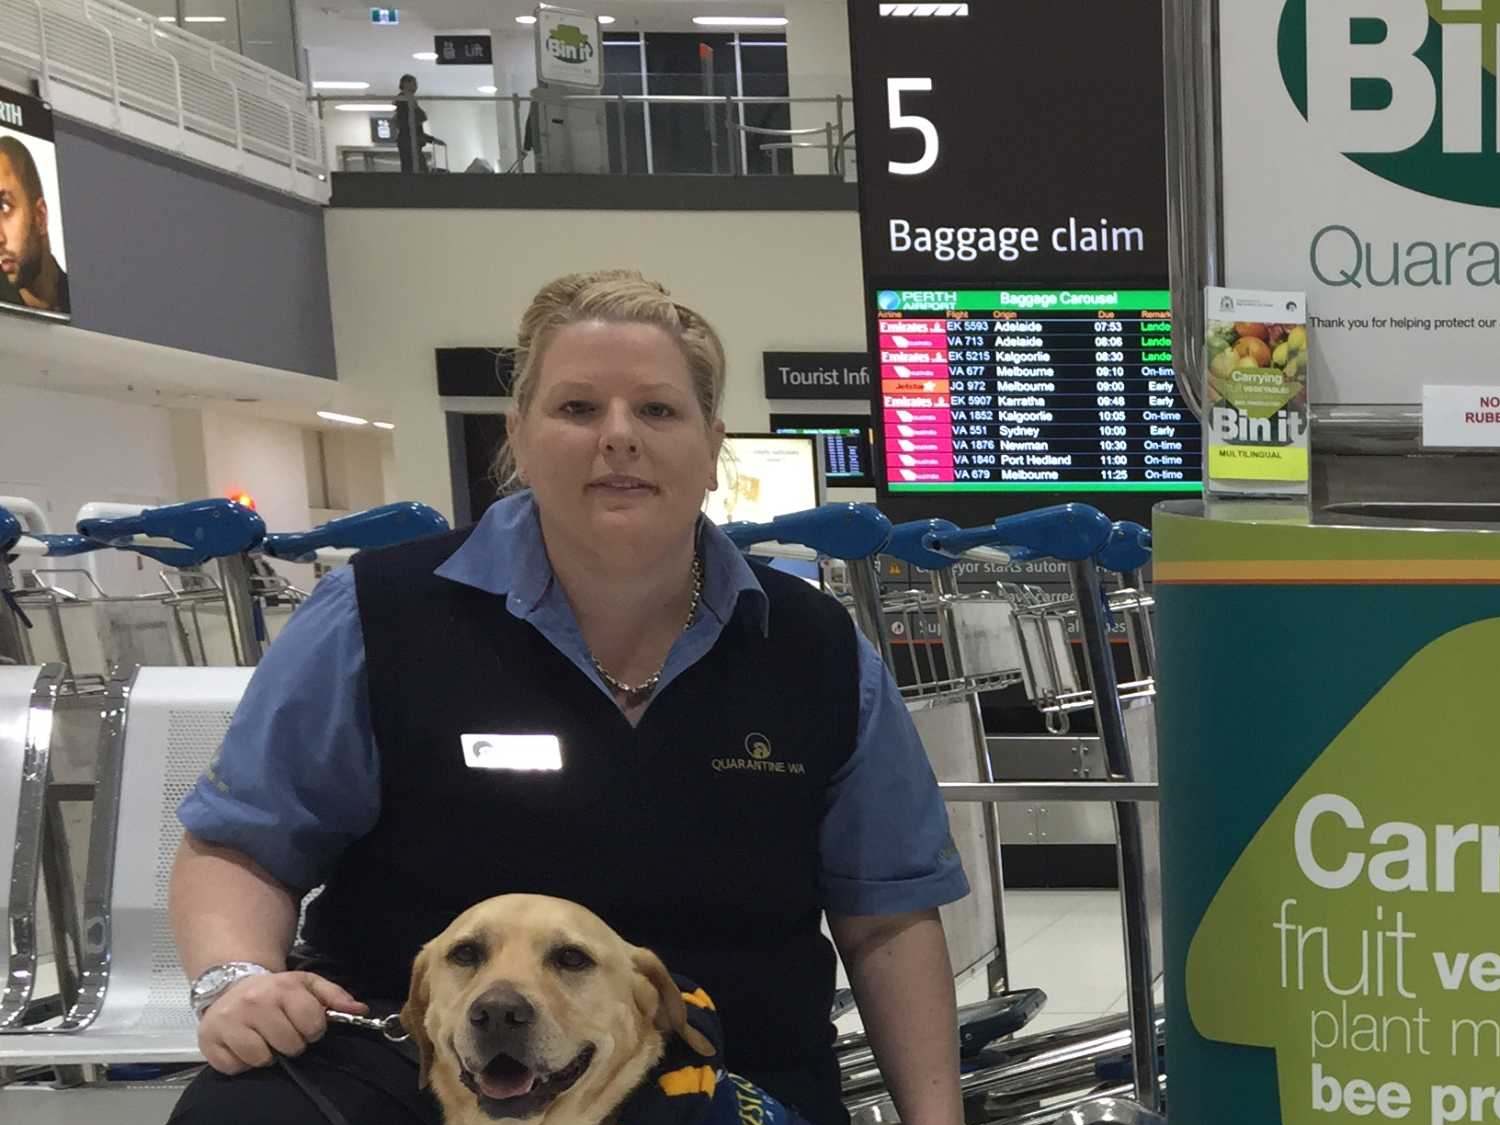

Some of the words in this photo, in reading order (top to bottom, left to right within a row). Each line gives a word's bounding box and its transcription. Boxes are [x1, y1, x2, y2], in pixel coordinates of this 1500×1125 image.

[464, 44, 484, 57] Lift
[551, 38, 579, 60] Bin
[886, 77, 940, 175] 5
[888, 219, 1039, 262] Baggage
[1051, 217, 1144, 251] claim
[902, 291, 957, 301] PERTH
[1000, 291, 1058, 308] Baggage
[1060, 291, 1118, 304] Carousel
[1098, 310, 1115, 319] Due
[946, 321, 962, 331] EK
[964, 321, 989, 331] 5593
[994, 321, 1043, 332] Adelaide
[1094, 322, 1123, 332] 07:53
[1309, 316, 1345, 328] Thank
[1348, 318, 1369, 331] you
[1371, 317, 1387, 328] for
[1390, 317, 1431, 331] helping
[1434, 317, 1475, 331] protect
[1477, 319, 1496, 328] our
[947, 336, 963, 346] VA
[964, 336, 984, 346] 713
[995, 336, 1043, 347] Adelaide
[948, 351, 963, 361] EK
[965, 351, 991, 361] 5215
[996, 351, 1051, 364] Kalgoorlie
[778, 367, 839, 385] Tourist
[948, 366, 964, 376] VA
[966, 366, 985, 376] 677
[996, 366, 1055, 377] Melbourne
[1231, 370, 1282, 384] Carrying
[950, 381, 964, 391] JQ
[966, 381, 986, 391] 972
[997, 381, 1055, 392] Melbourne
[1096, 381, 1125, 391] 09:00
[1148, 381, 1174, 393] Early
[950, 395, 966, 406] EK
[968, 395, 993, 406] 5907
[998, 395, 1046, 407] Karratha
[1149, 395, 1174, 408] Early
[1480, 396, 1500, 408] NO
[951, 410, 967, 420] VA
[969, 410, 994, 420] 1852
[998, 410, 1053, 423] Kalgoorlie
[1098, 411, 1126, 421] 10:05
[1142, 410, 1181, 421] On-time
[1212, 407, 1272, 442] Bin
[1277, 409, 1303, 442] it
[952, 425, 968, 435] VA
[969, 425, 987, 435] 551
[999, 425, 1040, 438] Sydney
[1099, 426, 1127, 436] 10:00
[1149, 425, 1175, 438] Early
[952, 440, 968, 450] VA
[970, 440, 995, 450] 1876
[1000, 440, 1049, 451] Newman
[1099, 440, 1127, 451] 10:30
[1143, 440, 1182, 450] On-time
[953, 454, 969, 464] VA
[971, 454, 996, 464] 1840
[1001, 454, 1024, 465] Port
[1026, 454, 1072, 465] Hedland
[1100, 455, 1128, 465] 11:00
[1144, 454, 1183, 465] On-time
[1219, 450, 1283, 460] MULTILINGUAL
[954, 469, 970, 479] VA
[971, 469, 991, 479] 679
[1001, 469, 1059, 480] Melbourne
[1100, 470, 1129, 480] 11:25
[1144, 469, 1184, 480] On-time
[1273, 899, 1416, 998] fruit
[1311, 1001, 1430, 1057] plant
[1311, 1063, 1411, 1117] bee
